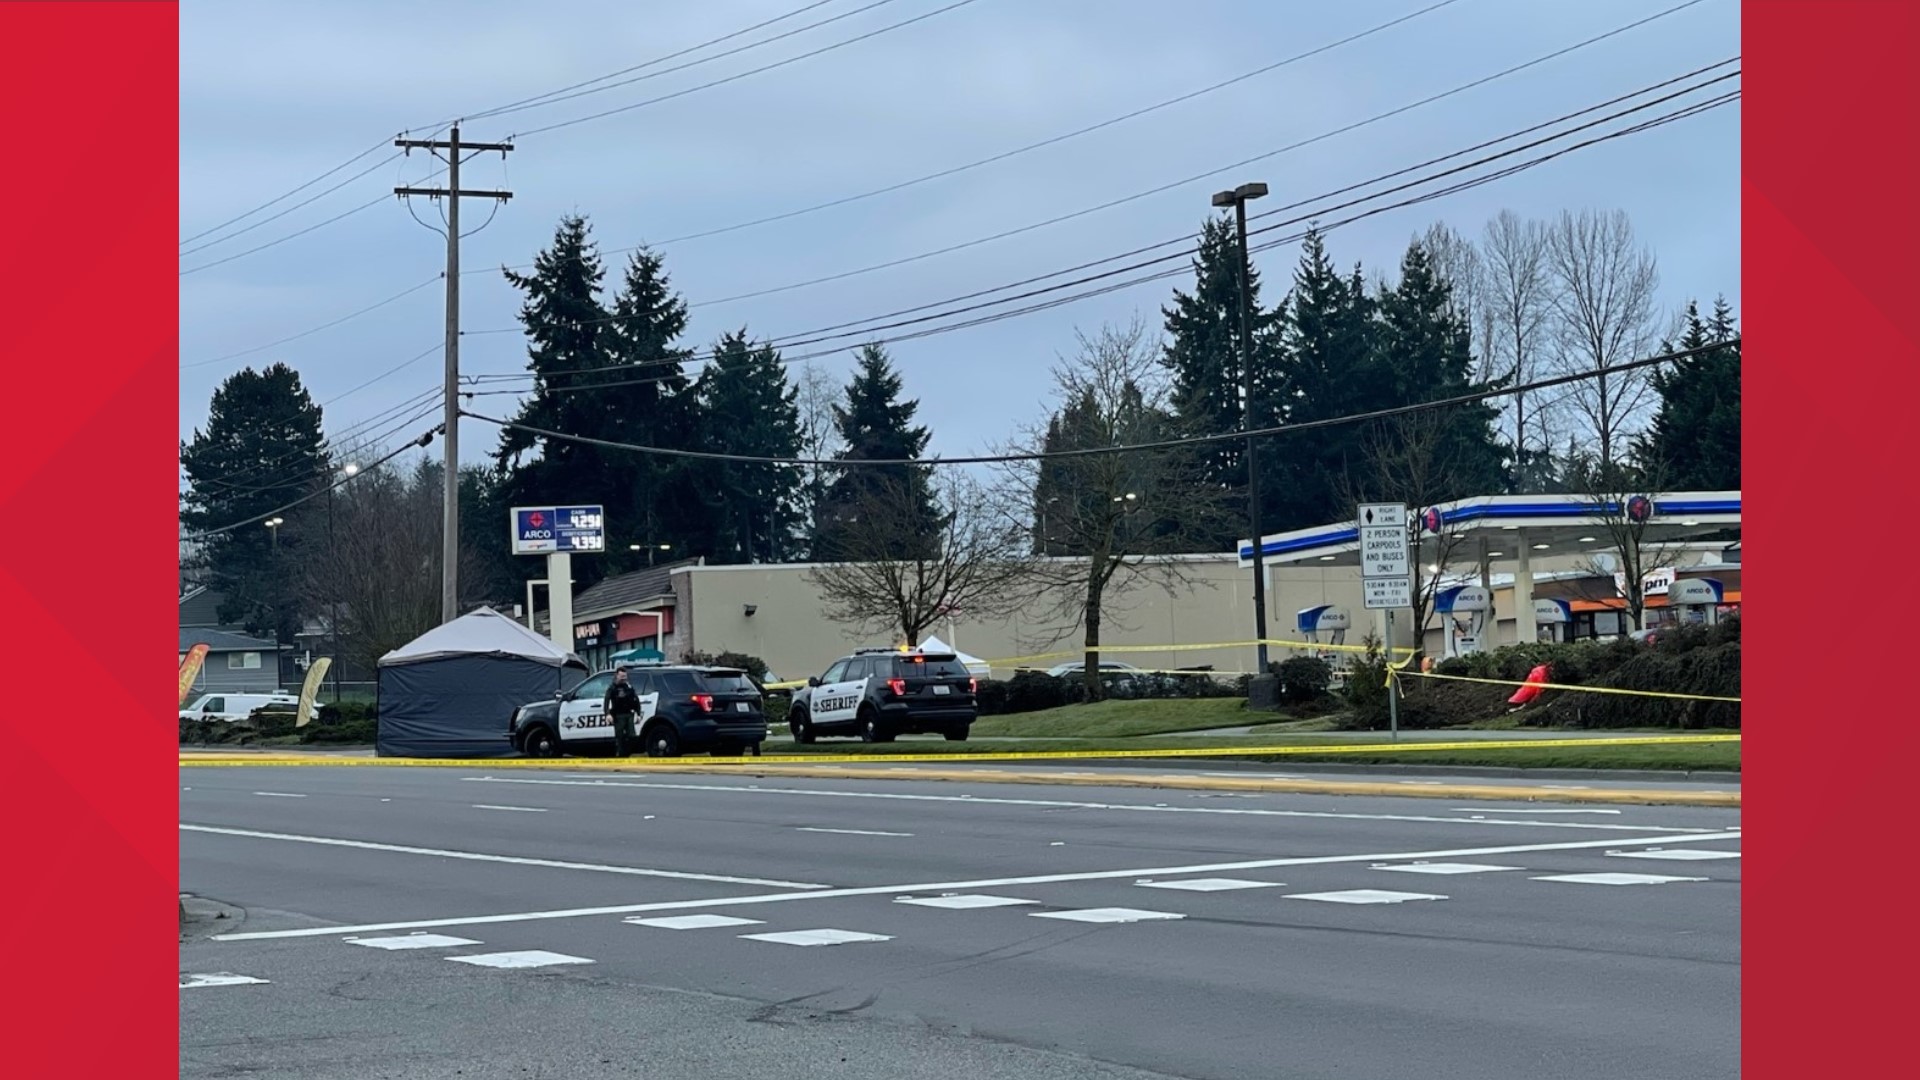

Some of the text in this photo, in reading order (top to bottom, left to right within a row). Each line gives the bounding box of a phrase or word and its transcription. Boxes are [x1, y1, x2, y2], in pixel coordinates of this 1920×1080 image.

[524, 530, 551, 539] ARCO
[1367, 530, 1401, 538] 2 PERSON
[1367, 541, 1401, 550] CARPOOLS
[1366, 551, 1404, 561] AND BUSES
[1377, 564, 1394, 573] ONLY
[820, 695, 859, 712] SHERIFF
